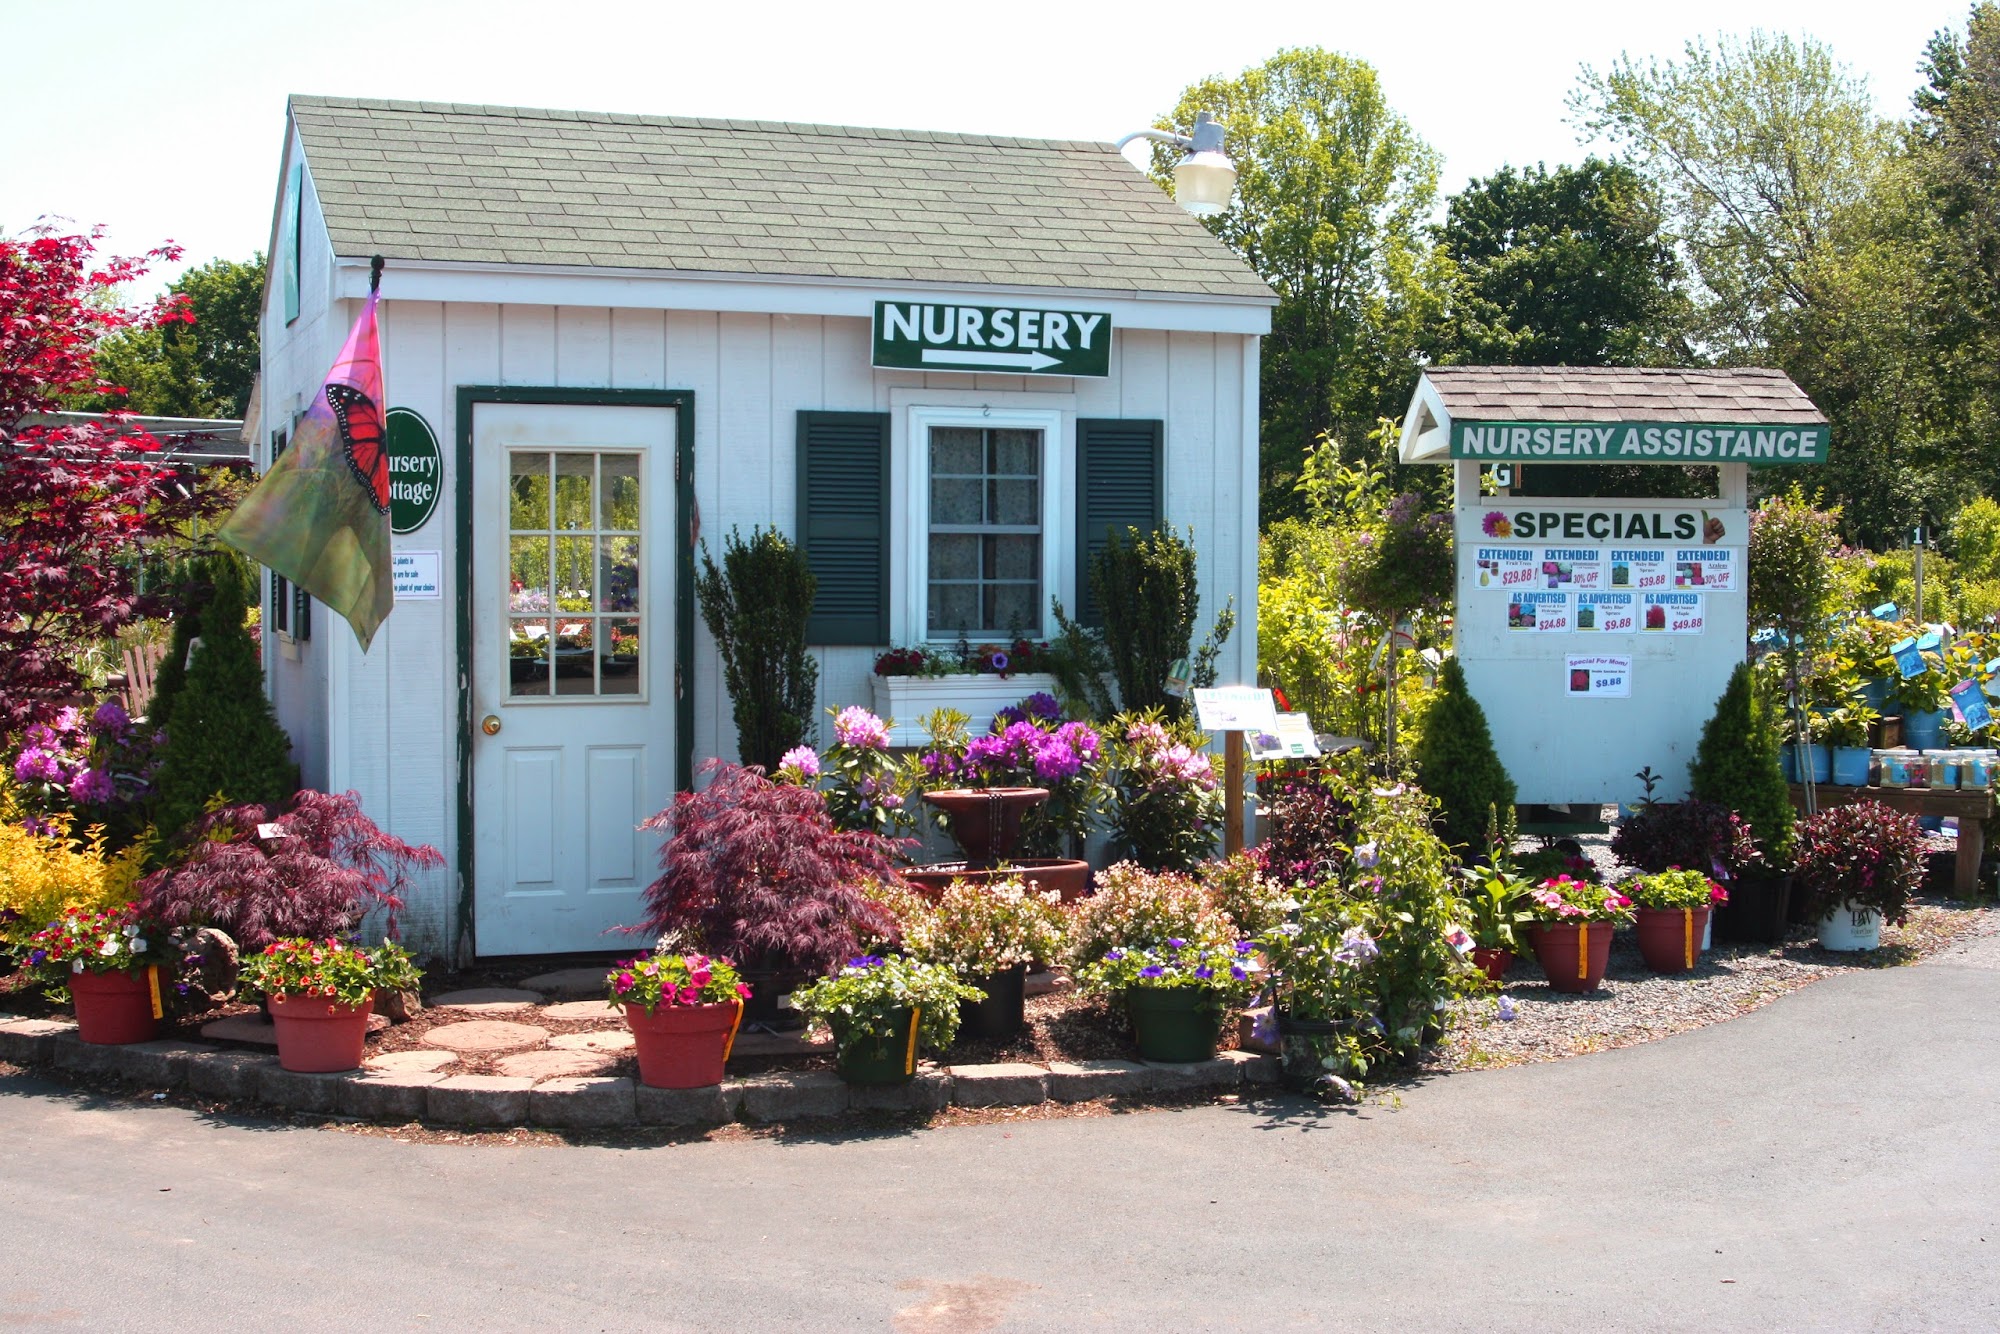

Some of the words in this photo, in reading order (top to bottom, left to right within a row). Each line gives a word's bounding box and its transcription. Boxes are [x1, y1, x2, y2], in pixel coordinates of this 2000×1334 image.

[883, 304, 1103, 350] NURSERY
[1462, 427, 1615, 455] NURSERY
[1620, 427, 1818, 458] ASSISTANCE
[1491, 463, 1511, 487] G
[1513, 511, 1696, 539] SPECIALS
[1913, 528, 1923, 544] 1
[1479, 549, 1533, 561] EXTENDED!
[1545, 550, 1599, 561] EXTENDED!
[1611, 550, 1664, 561] EXTENDED!
[1677, 551, 1730, 561] EXTENDED!
[1502, 569, 1532, 586] $29.88
[1573, 574, 1586, 584] 30%
[1587, 572, 1599, 582] OFF
[1639, 575, 1665, 588] $39.88
[1704, 575, 1717, 584] 30%
[1718, 573, 1730, 583] OFF
[1513, 593, 1522, 603] AS
[1523, 593, 1566, 603] ADVERTISED
[1578, 594, 1588, 603] AS
[1588, 594, 1631, 604] ADVERTISED
[1645, 594, 1654, 604] AS
[1656, 594, 1698, 604] ADVERTISED
[1539, 618, 1566, 631] $24.88
[1604, 617, 1631, 631] $9.88
[1672, 618, 1702, 631] $49.88
[1569, 658, 1595, 666] Special
[1595, 677, 1621, 688] $9.88
